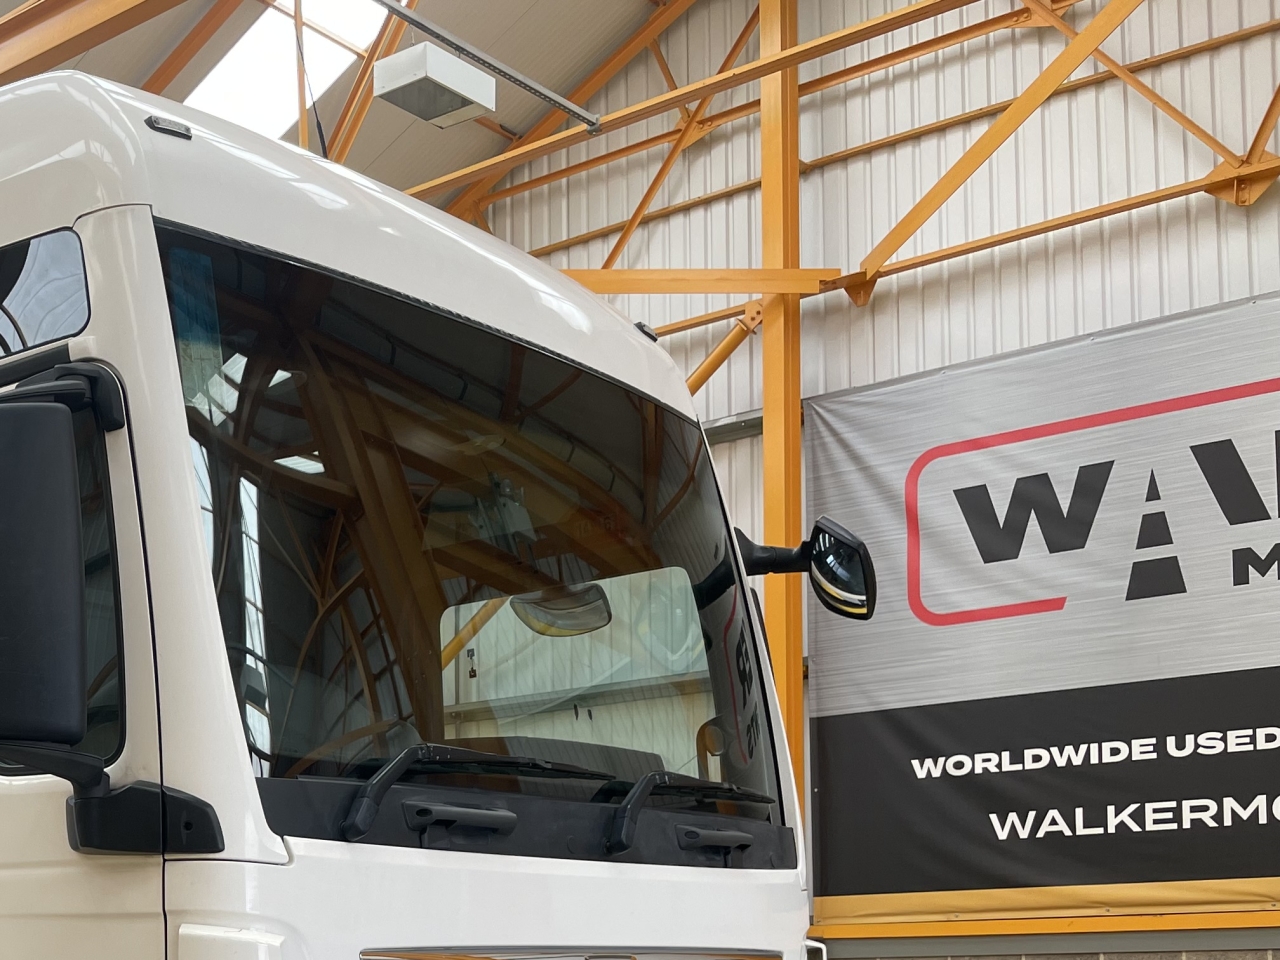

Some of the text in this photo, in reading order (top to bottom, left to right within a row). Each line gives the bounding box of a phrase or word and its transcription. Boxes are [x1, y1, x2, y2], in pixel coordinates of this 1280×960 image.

[952, 430, 1280, 602] WA
[911, 726, 1280, 779] WORLDWIDE USED
[988, 794, 1280, 841] WALKERM
